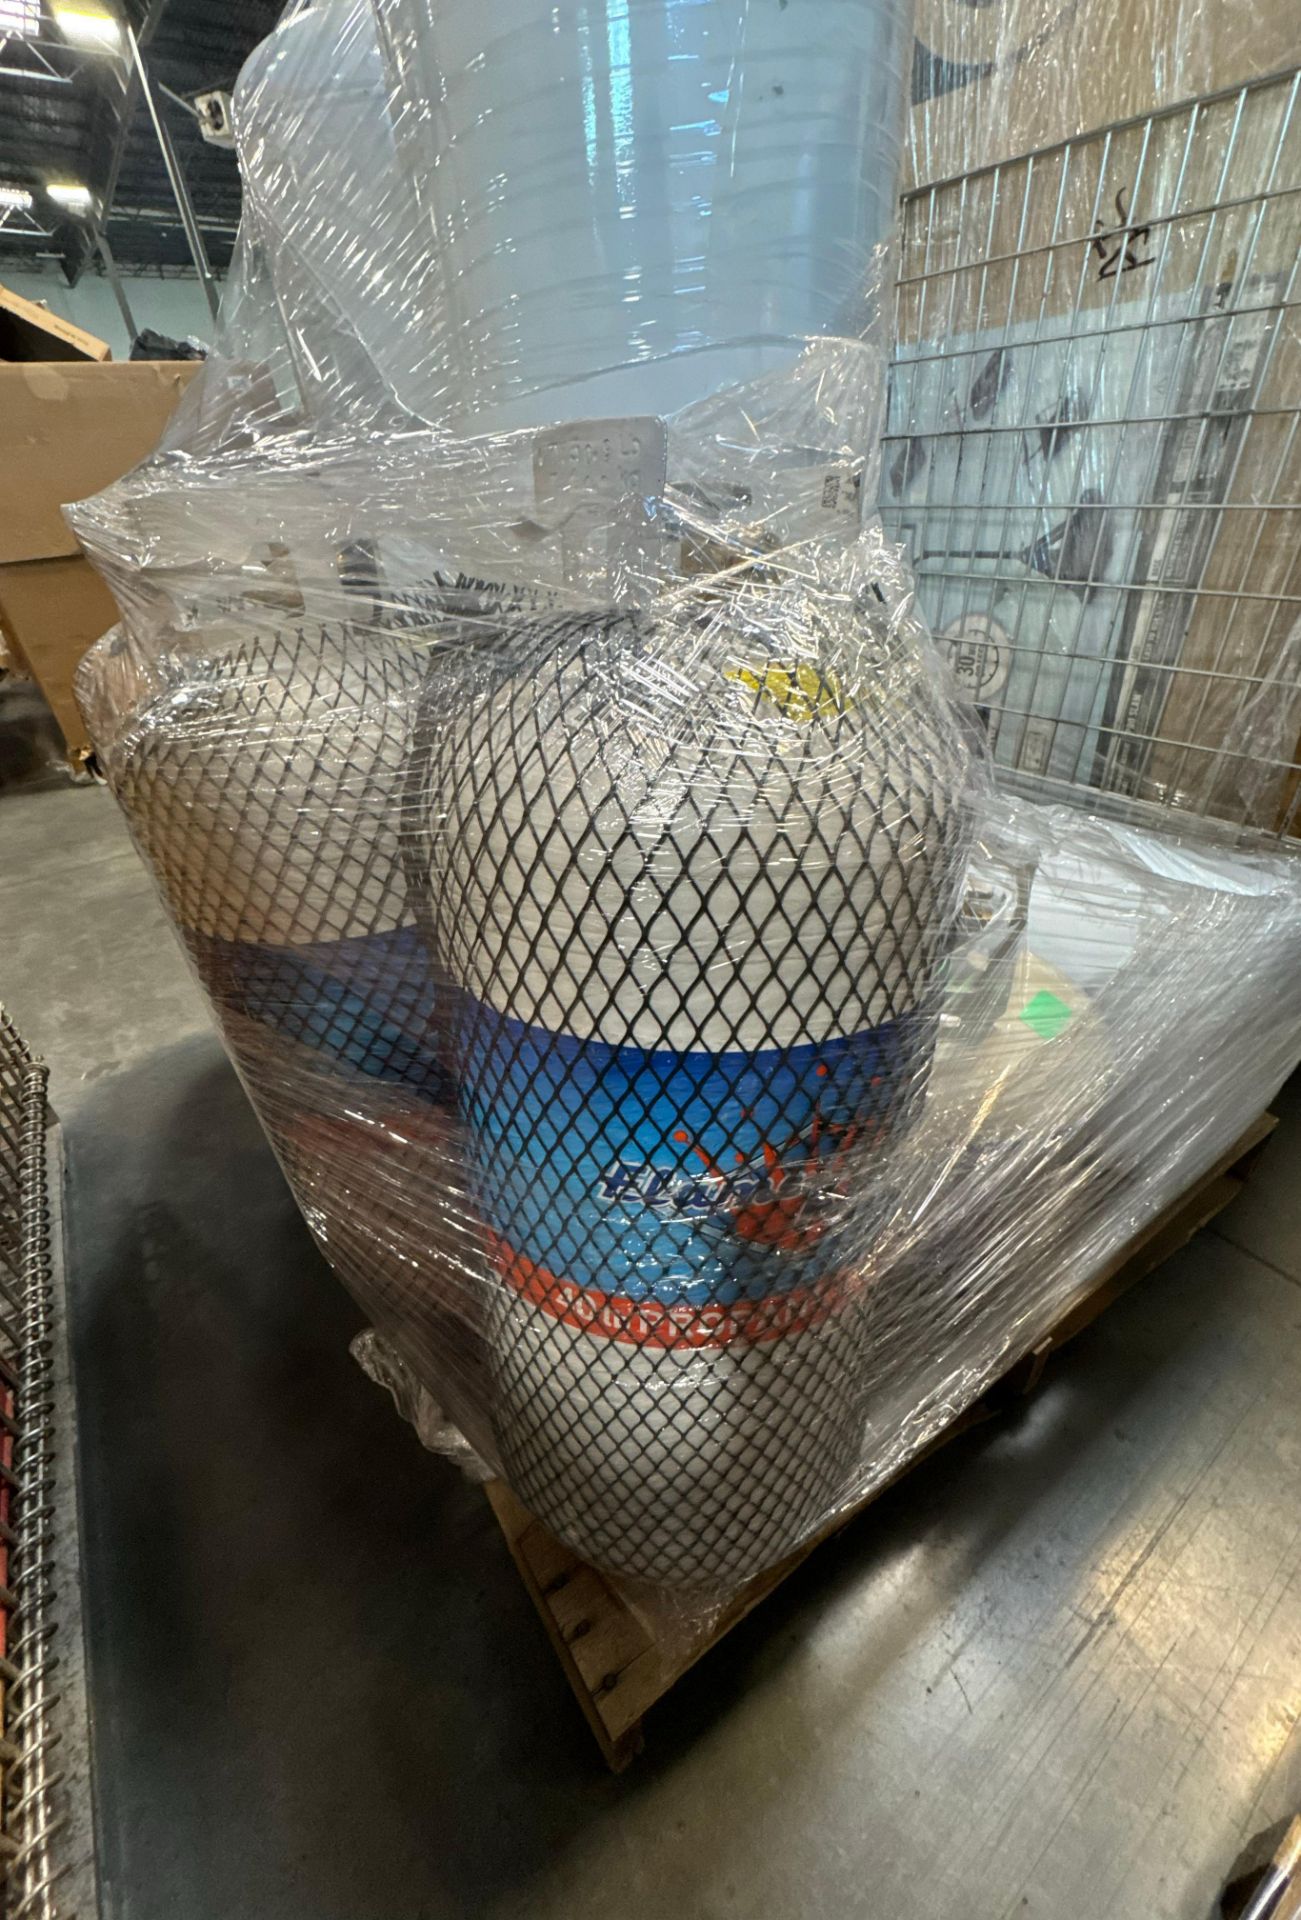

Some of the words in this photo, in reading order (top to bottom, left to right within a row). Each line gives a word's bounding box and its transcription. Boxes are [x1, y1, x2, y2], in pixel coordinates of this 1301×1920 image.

[955, 655, 977, 677] 30
[555, 1285, 598, 1322] 40
[638, 1286, 834, 1338] PROPAN
